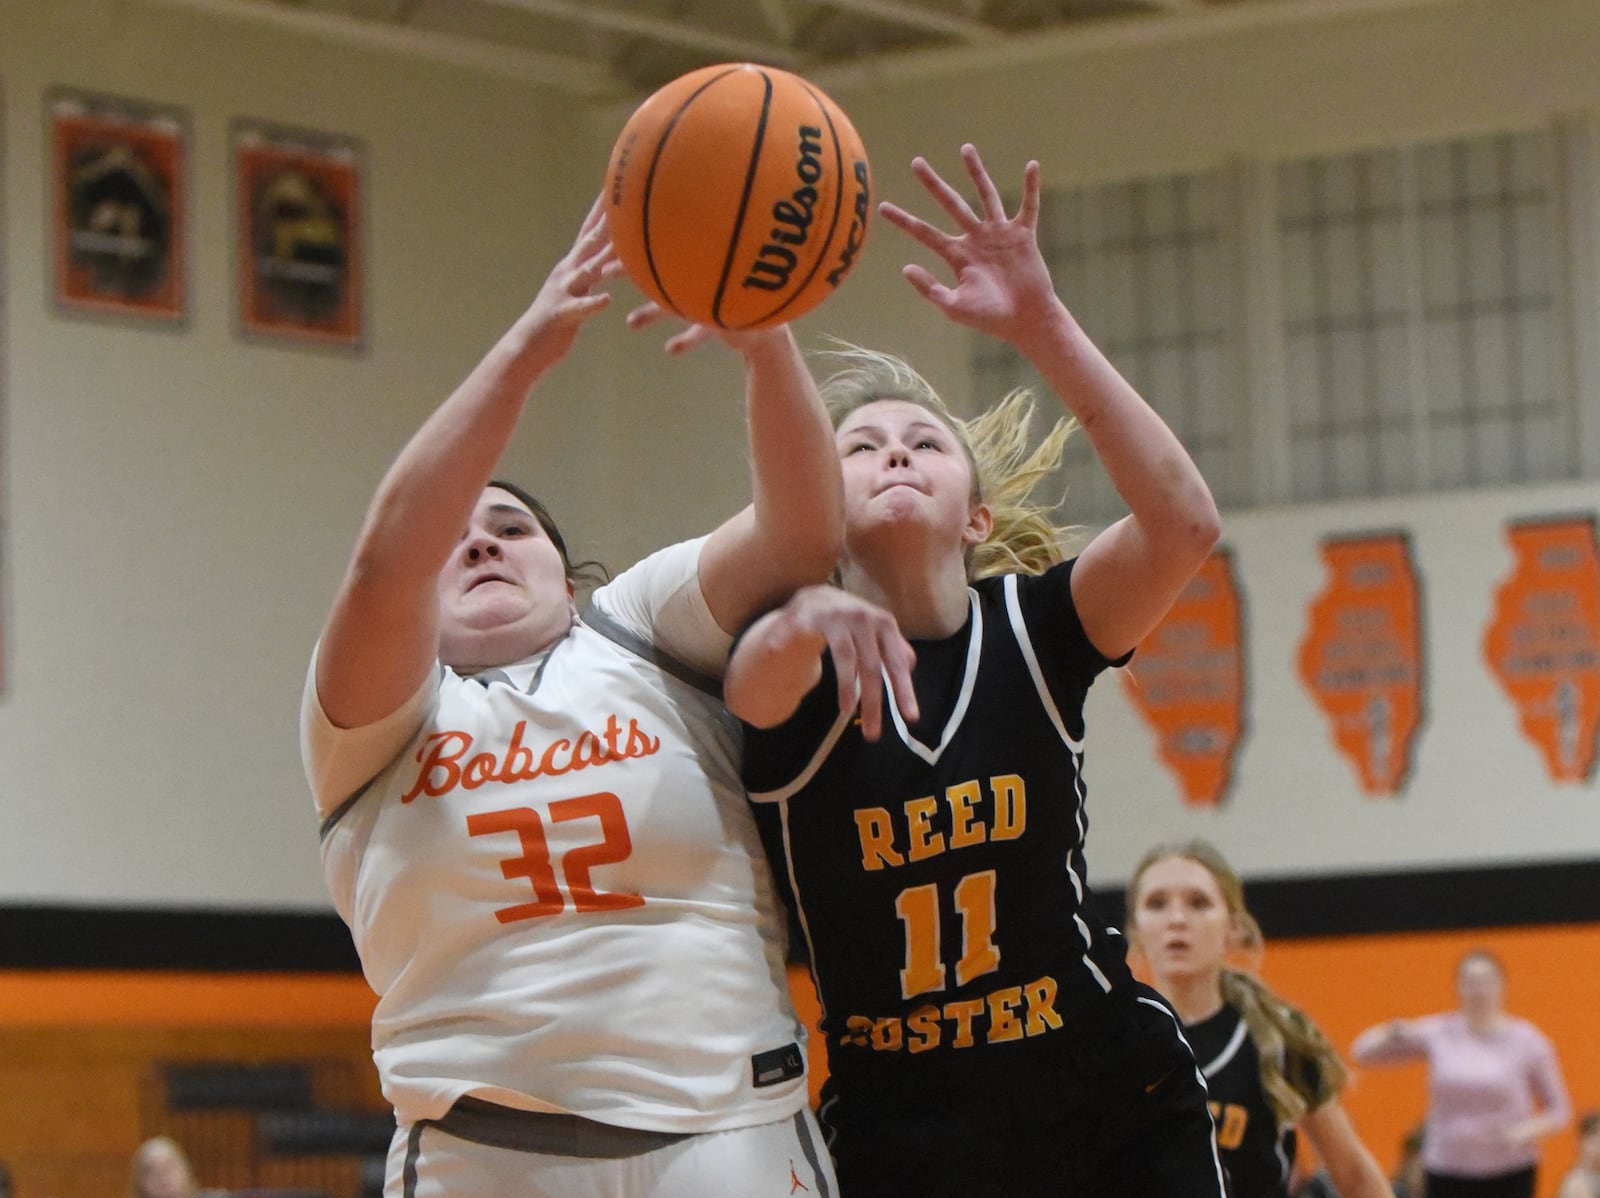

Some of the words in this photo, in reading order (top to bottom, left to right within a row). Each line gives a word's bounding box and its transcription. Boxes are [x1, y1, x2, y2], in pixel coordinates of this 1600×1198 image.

[742, 125, 822, 292] Wilson
[401, 713, 661, 804] Bobcats
[465, 791, 647, 925] 32
[853, 773, 1027, 871] REED
[894, 868, 1001, 1001] 11
[786, 1054, 799, 1068] XL
